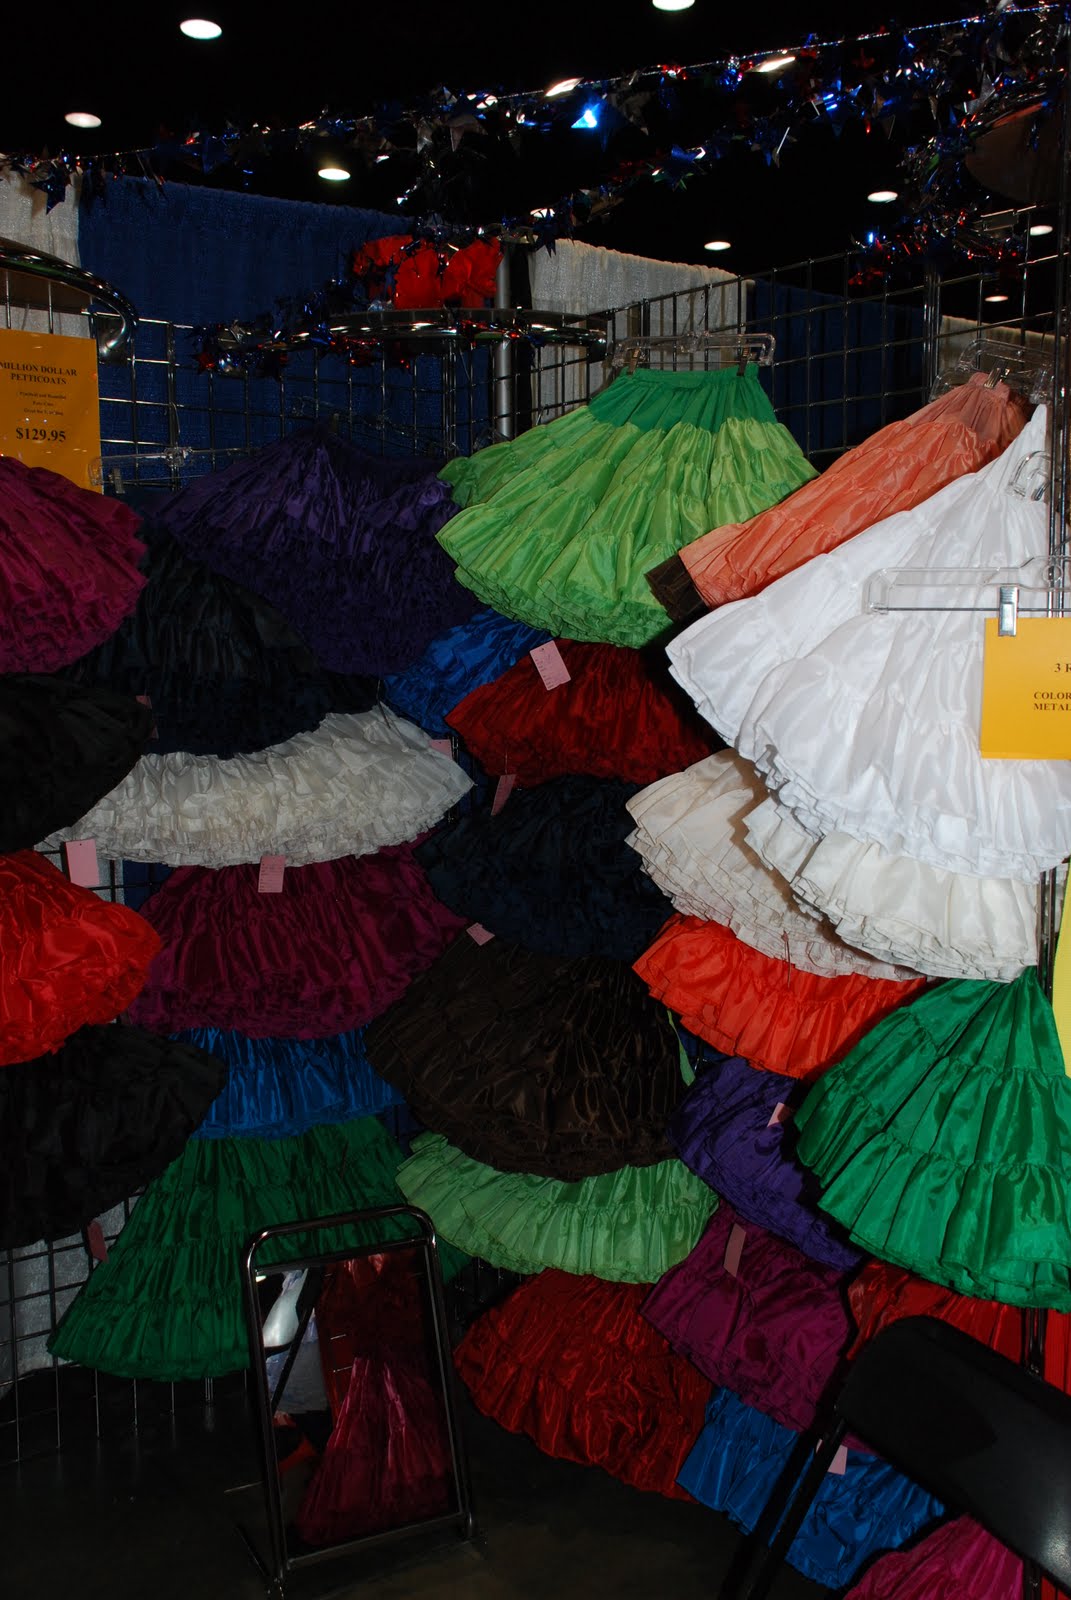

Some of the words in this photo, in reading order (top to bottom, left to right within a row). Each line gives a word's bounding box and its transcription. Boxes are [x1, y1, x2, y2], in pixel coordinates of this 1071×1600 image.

[40, 365, 77, 376] DOLLAR
[11, 373, 67, 384] PETTICOATS
[16, 427, 66, 442] $129.95
[1054, 663, 1061, 673] 3
[1033, 702, 1071, 711] METAL
